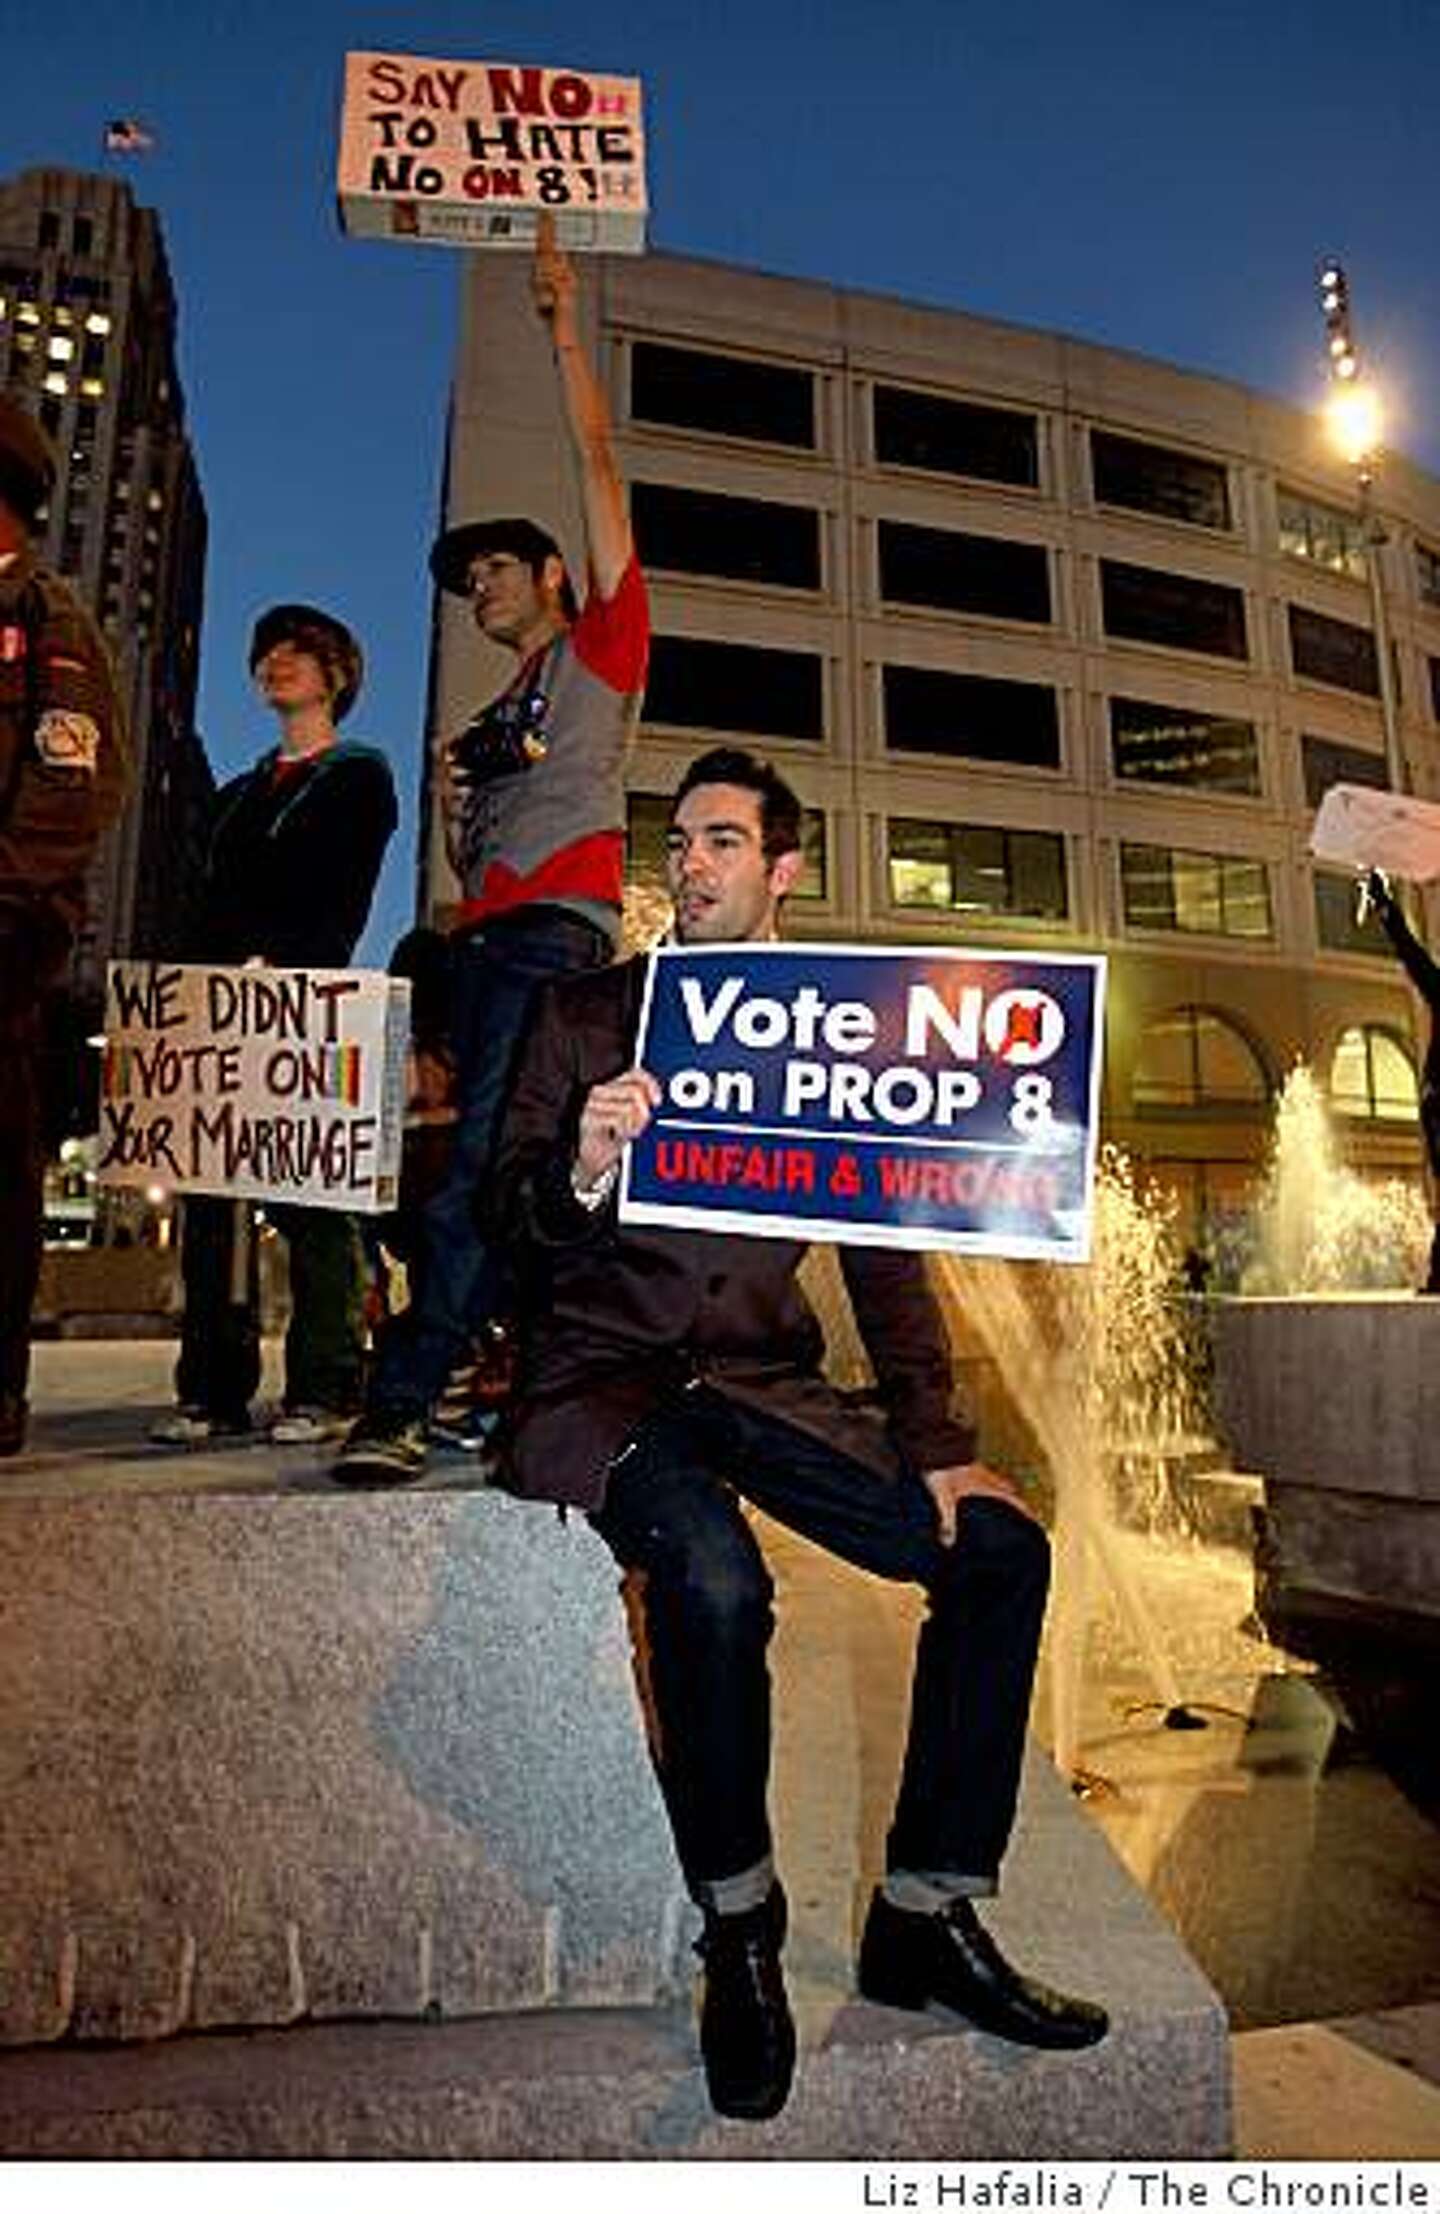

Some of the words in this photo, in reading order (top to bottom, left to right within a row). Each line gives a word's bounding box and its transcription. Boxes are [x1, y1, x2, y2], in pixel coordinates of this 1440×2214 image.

[368, 61, 468, 112] SAY
[487, 68, 593, 118] NO
[367, 112, 437, 148] TO
[465, 118, 633, 162] HATE
[370, 155, 443, 195] NO
[462, 164, 524, 198] ON
[112, 967, 187, 1030] WE
[679, 977, 876, 1053] Vote
[905, 984, 1065, 1065] NO
[133, 1037, 241, 1099] VOTE
[266, 1049, 326, 1099] ON
[669, 1067, 754, 1113] on
[783, 1061, 981, 1126] PROP
[1007, 1072, 1055, 1136] 8
[191, 1102, 377, 1190] MARRIAGE
[655, 1140, 815, 1193] UNFAIR
[829, 1154, 861, 1196] &
